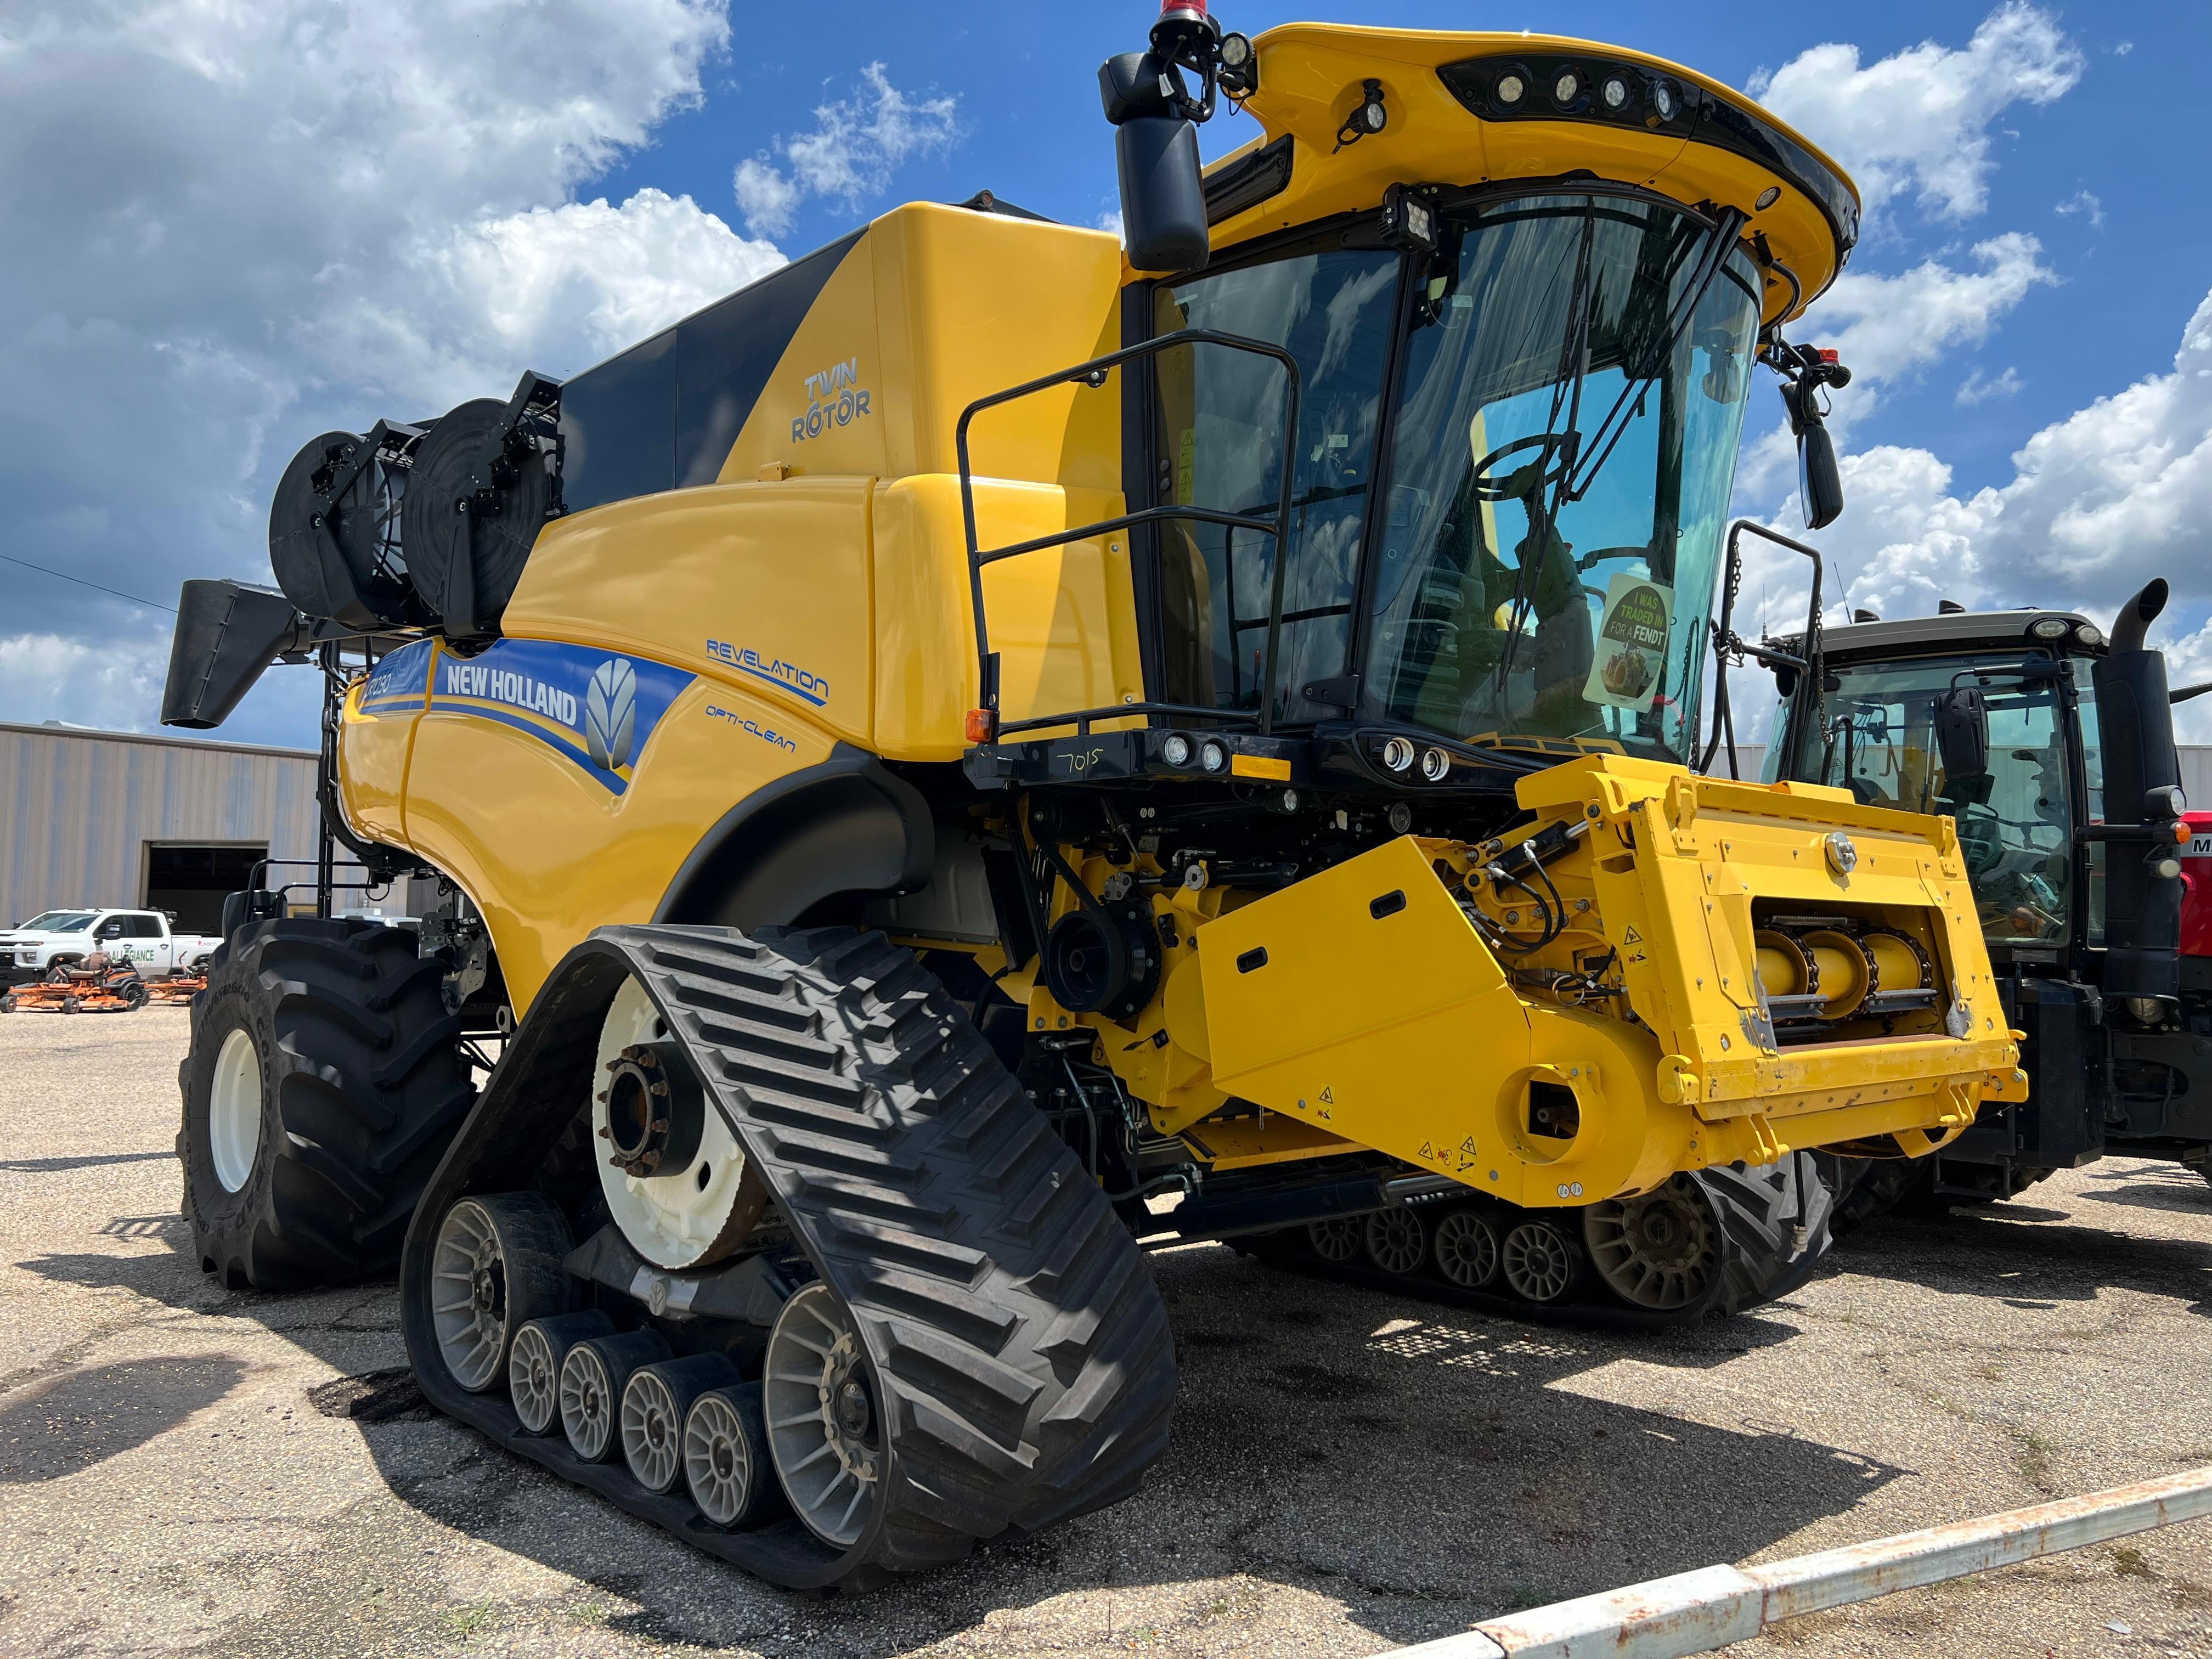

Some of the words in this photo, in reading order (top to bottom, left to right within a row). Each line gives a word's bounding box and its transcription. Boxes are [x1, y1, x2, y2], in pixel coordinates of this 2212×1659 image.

[804, 356, 857, 401] TWIN
[792, 389, 871, 443] ROTOR
[1622, 605, 1654, 626] TRADED
[1654, 616, 1663, 628] IN
[1634, 592, 1639, 604] I
[1639, 594, 1658, 610] WAS
[1610, 622, 1626, 636] FOR
[1626, 627, 1633, 640] A
[1633, 625, 1664, 646] FENDT
[707, 639, 828, 697] REVELATION
[448, 665, 488, 696] NEW
[491, 669, 577, 726] HOLLAND
[706, 706, 795, 753] OPTI-CLEAN
[1057, 748, 1103, 772] 7015
[2193, 839, 2212, 852] M
